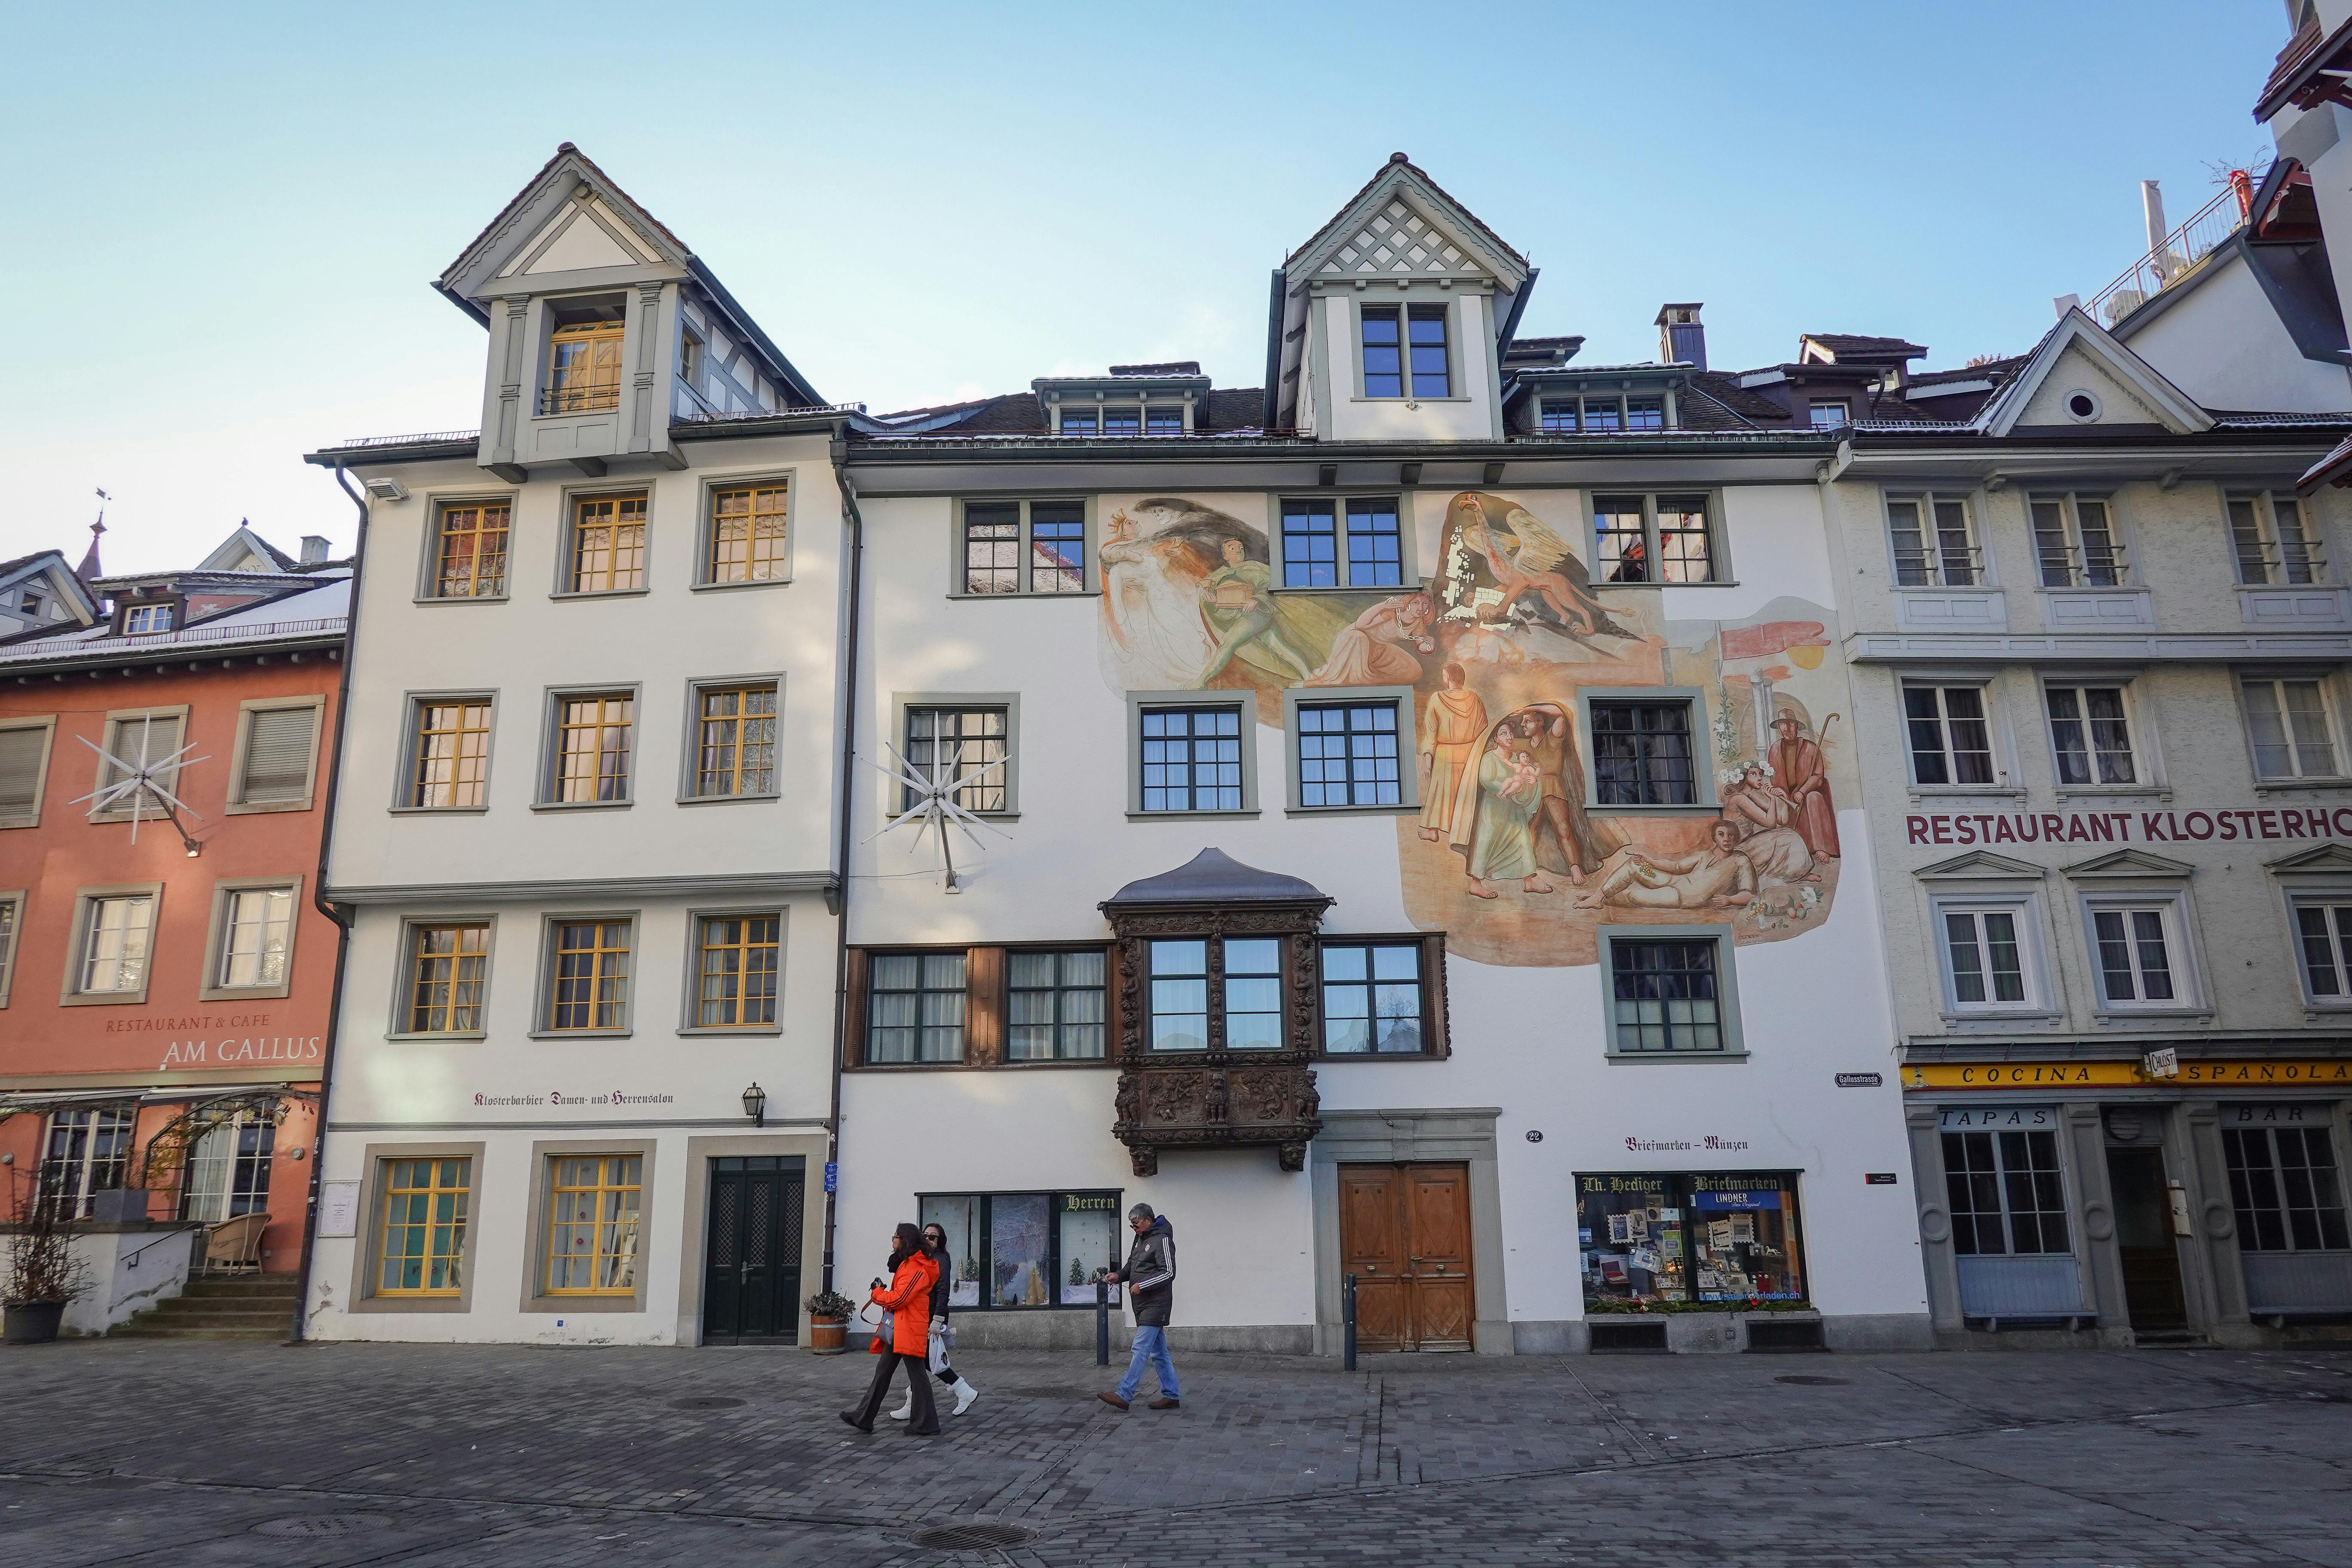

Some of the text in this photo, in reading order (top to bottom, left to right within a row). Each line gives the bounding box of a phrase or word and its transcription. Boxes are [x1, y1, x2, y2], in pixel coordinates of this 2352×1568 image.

[1907, 808, 2352, 845] RESTAURANT KLOSTERHO
[107, 1014, 270, 1032] RESTAURANT & CAFE
[162, 1036, 328, 1063] AM GALLUS
[1839, 1075, 1878, 1083] Gallusstrasse
[1962, 1065, 2347, 1082] COCINA SPAÑOLA
[475, 1090, 673, 1107] Klosterbarbier Damen- und Herrensalon
[1939, 1107, 2303, 1126] TAPAS BAR
[1529, 1132, 1540, 1140] 22
[1625, 1137, 1691, 1153] Briefmarken
[1704, 1135, 1749, 1152] Münzen
[1582, 1176, 1663, 1194] Th. Hediger
[1694, 1176, 1779, 1192] Briefmarken
[1066, 1194, 1115, 1211] Herren
[1715, 1193, 1748, 1203] LINDNER
